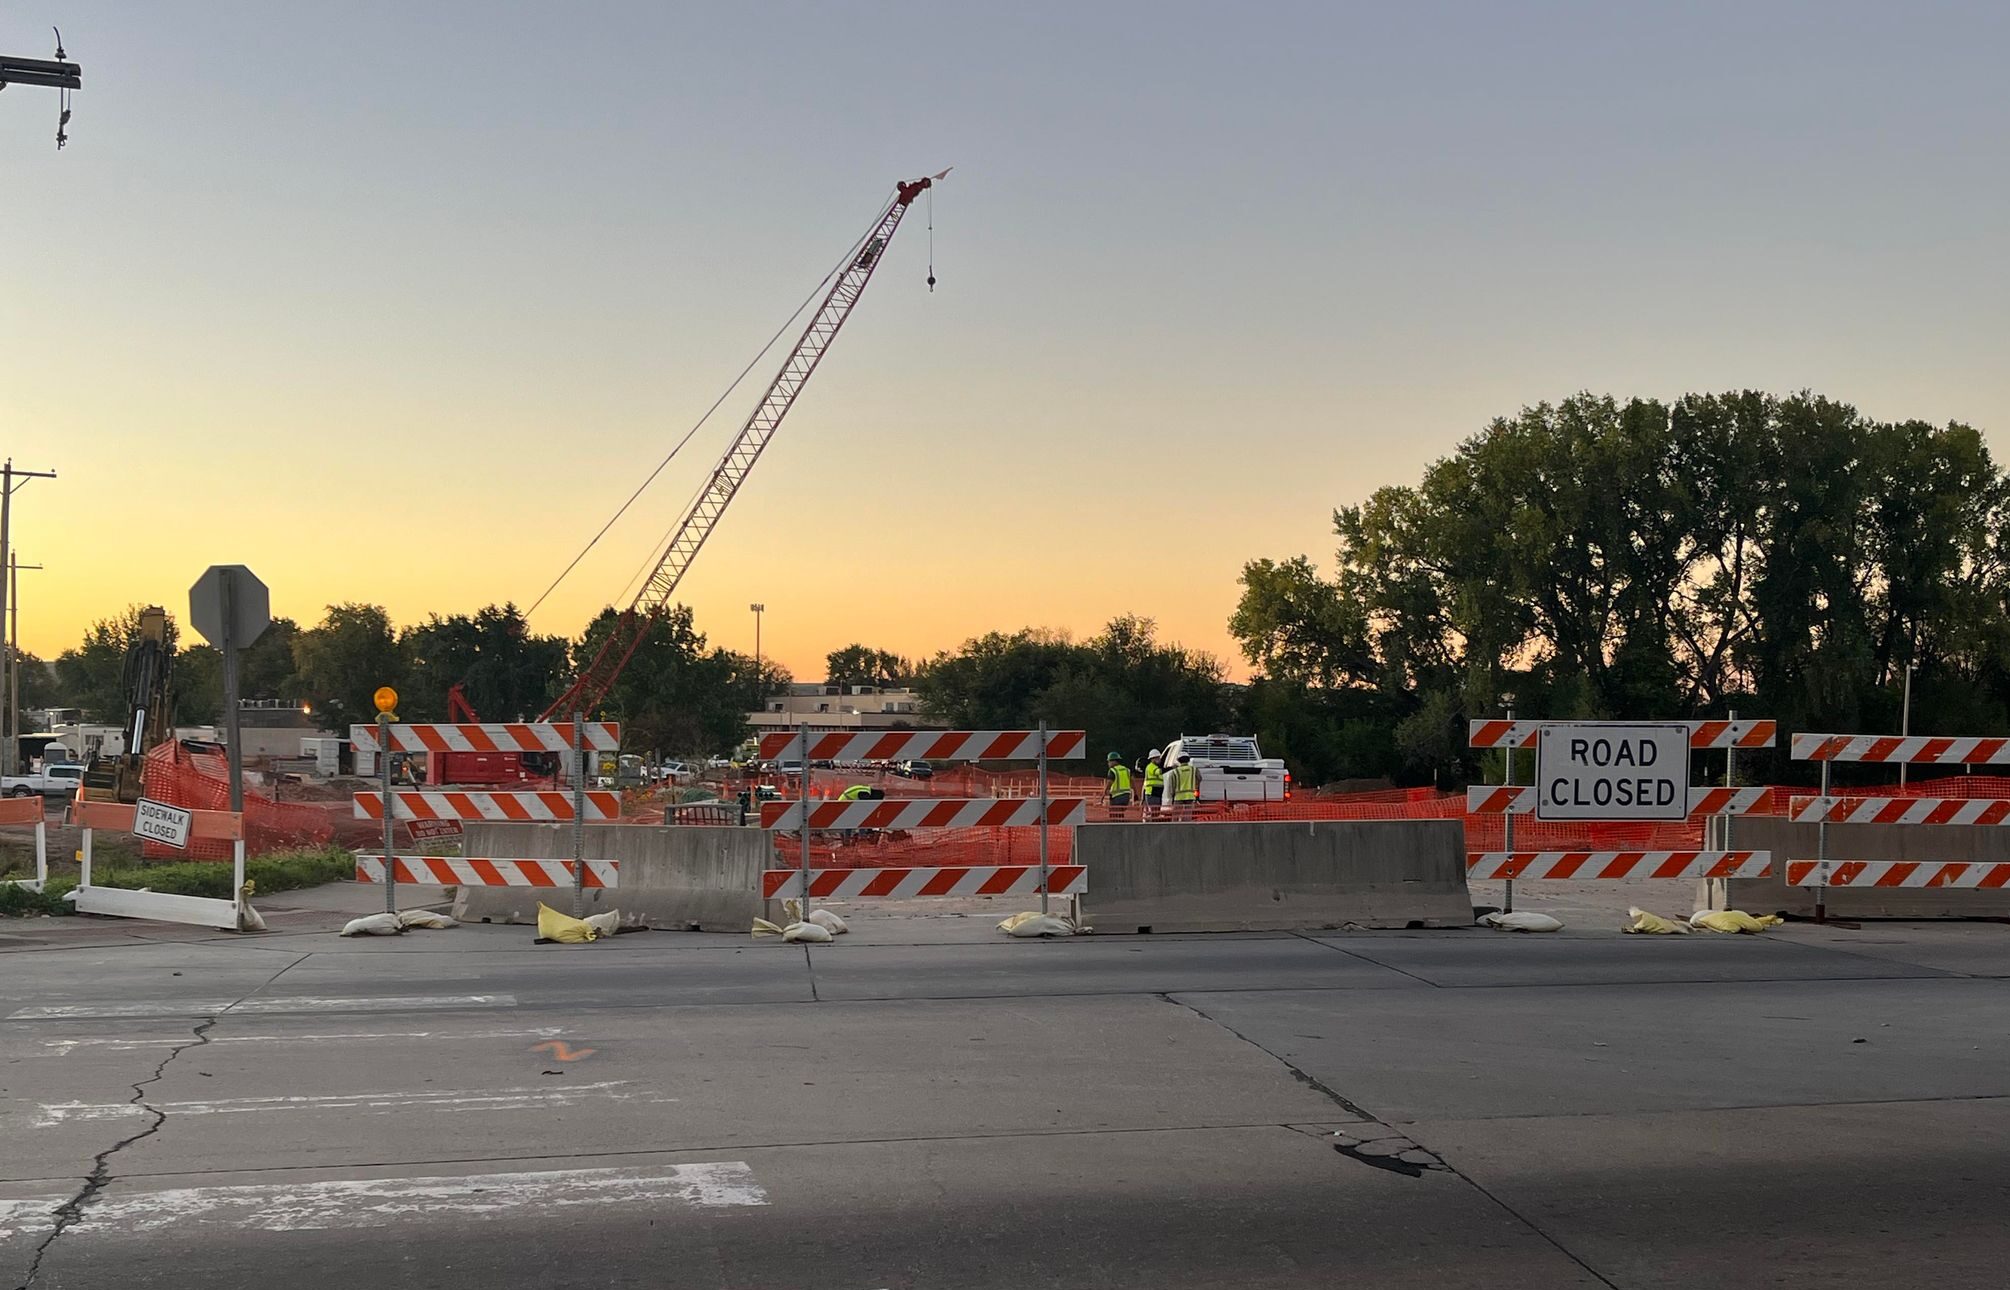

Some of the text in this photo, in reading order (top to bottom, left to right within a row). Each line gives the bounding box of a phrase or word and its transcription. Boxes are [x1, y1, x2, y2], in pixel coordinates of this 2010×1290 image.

[1571, 739, 1658, 767] ROAD
[1550, 777, 1675, 807] CLOSED
[140, 804, 185, 826] SIDEWALK
[142, 820, 177, 839] CLOSED
